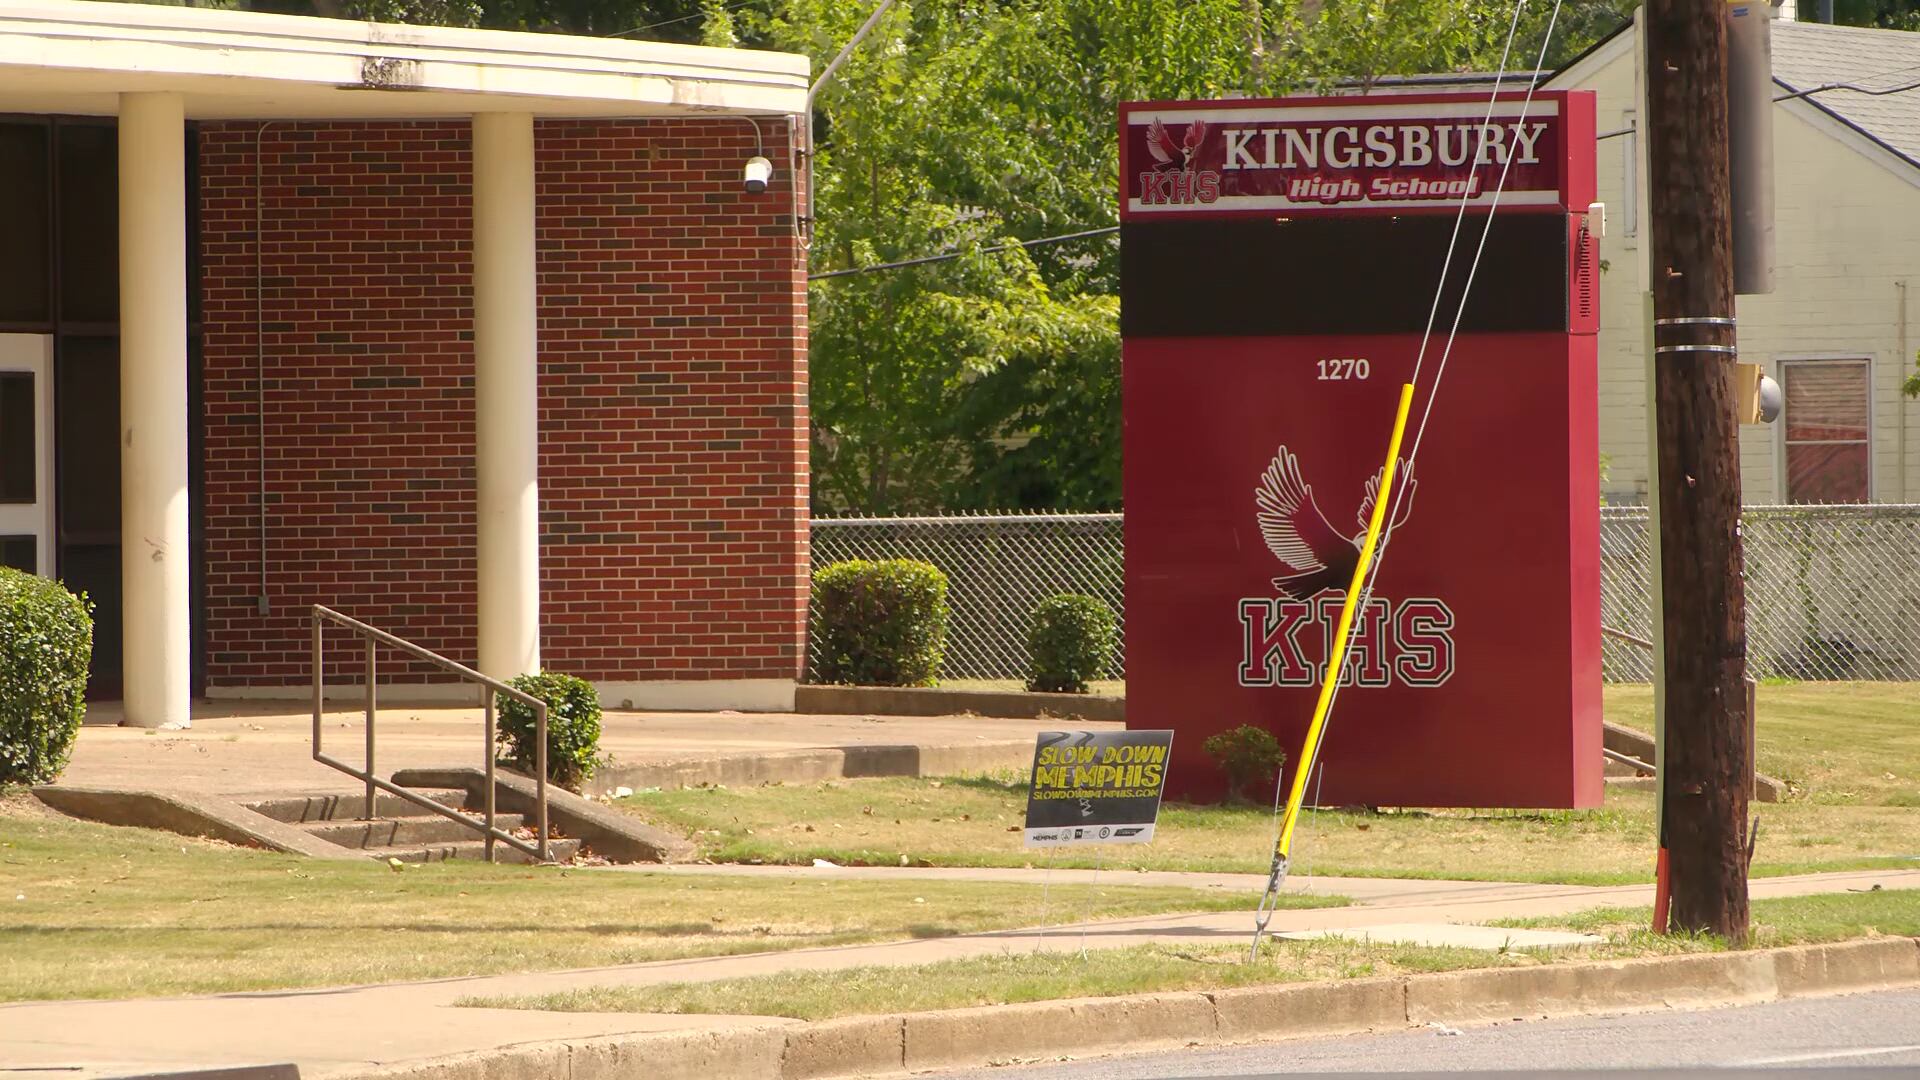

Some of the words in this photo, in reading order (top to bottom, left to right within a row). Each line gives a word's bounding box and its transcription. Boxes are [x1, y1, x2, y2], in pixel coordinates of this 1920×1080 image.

[1221, 122, 1548, 171] KINGSBURY
[1140, 170, 1220, 205] KHS
[1289, 176, 1361, 199] High
[1371, 176, 1479, 197] School
[1316, 358, 1370, 380] 1270
[1238, 597, 1455, 688] KHS
[1039, 745, 1099, 765] SLOW
[1102, 745, 1167, 764] DOWN
[1035, 764, 1163, 789] MEMPHIS
